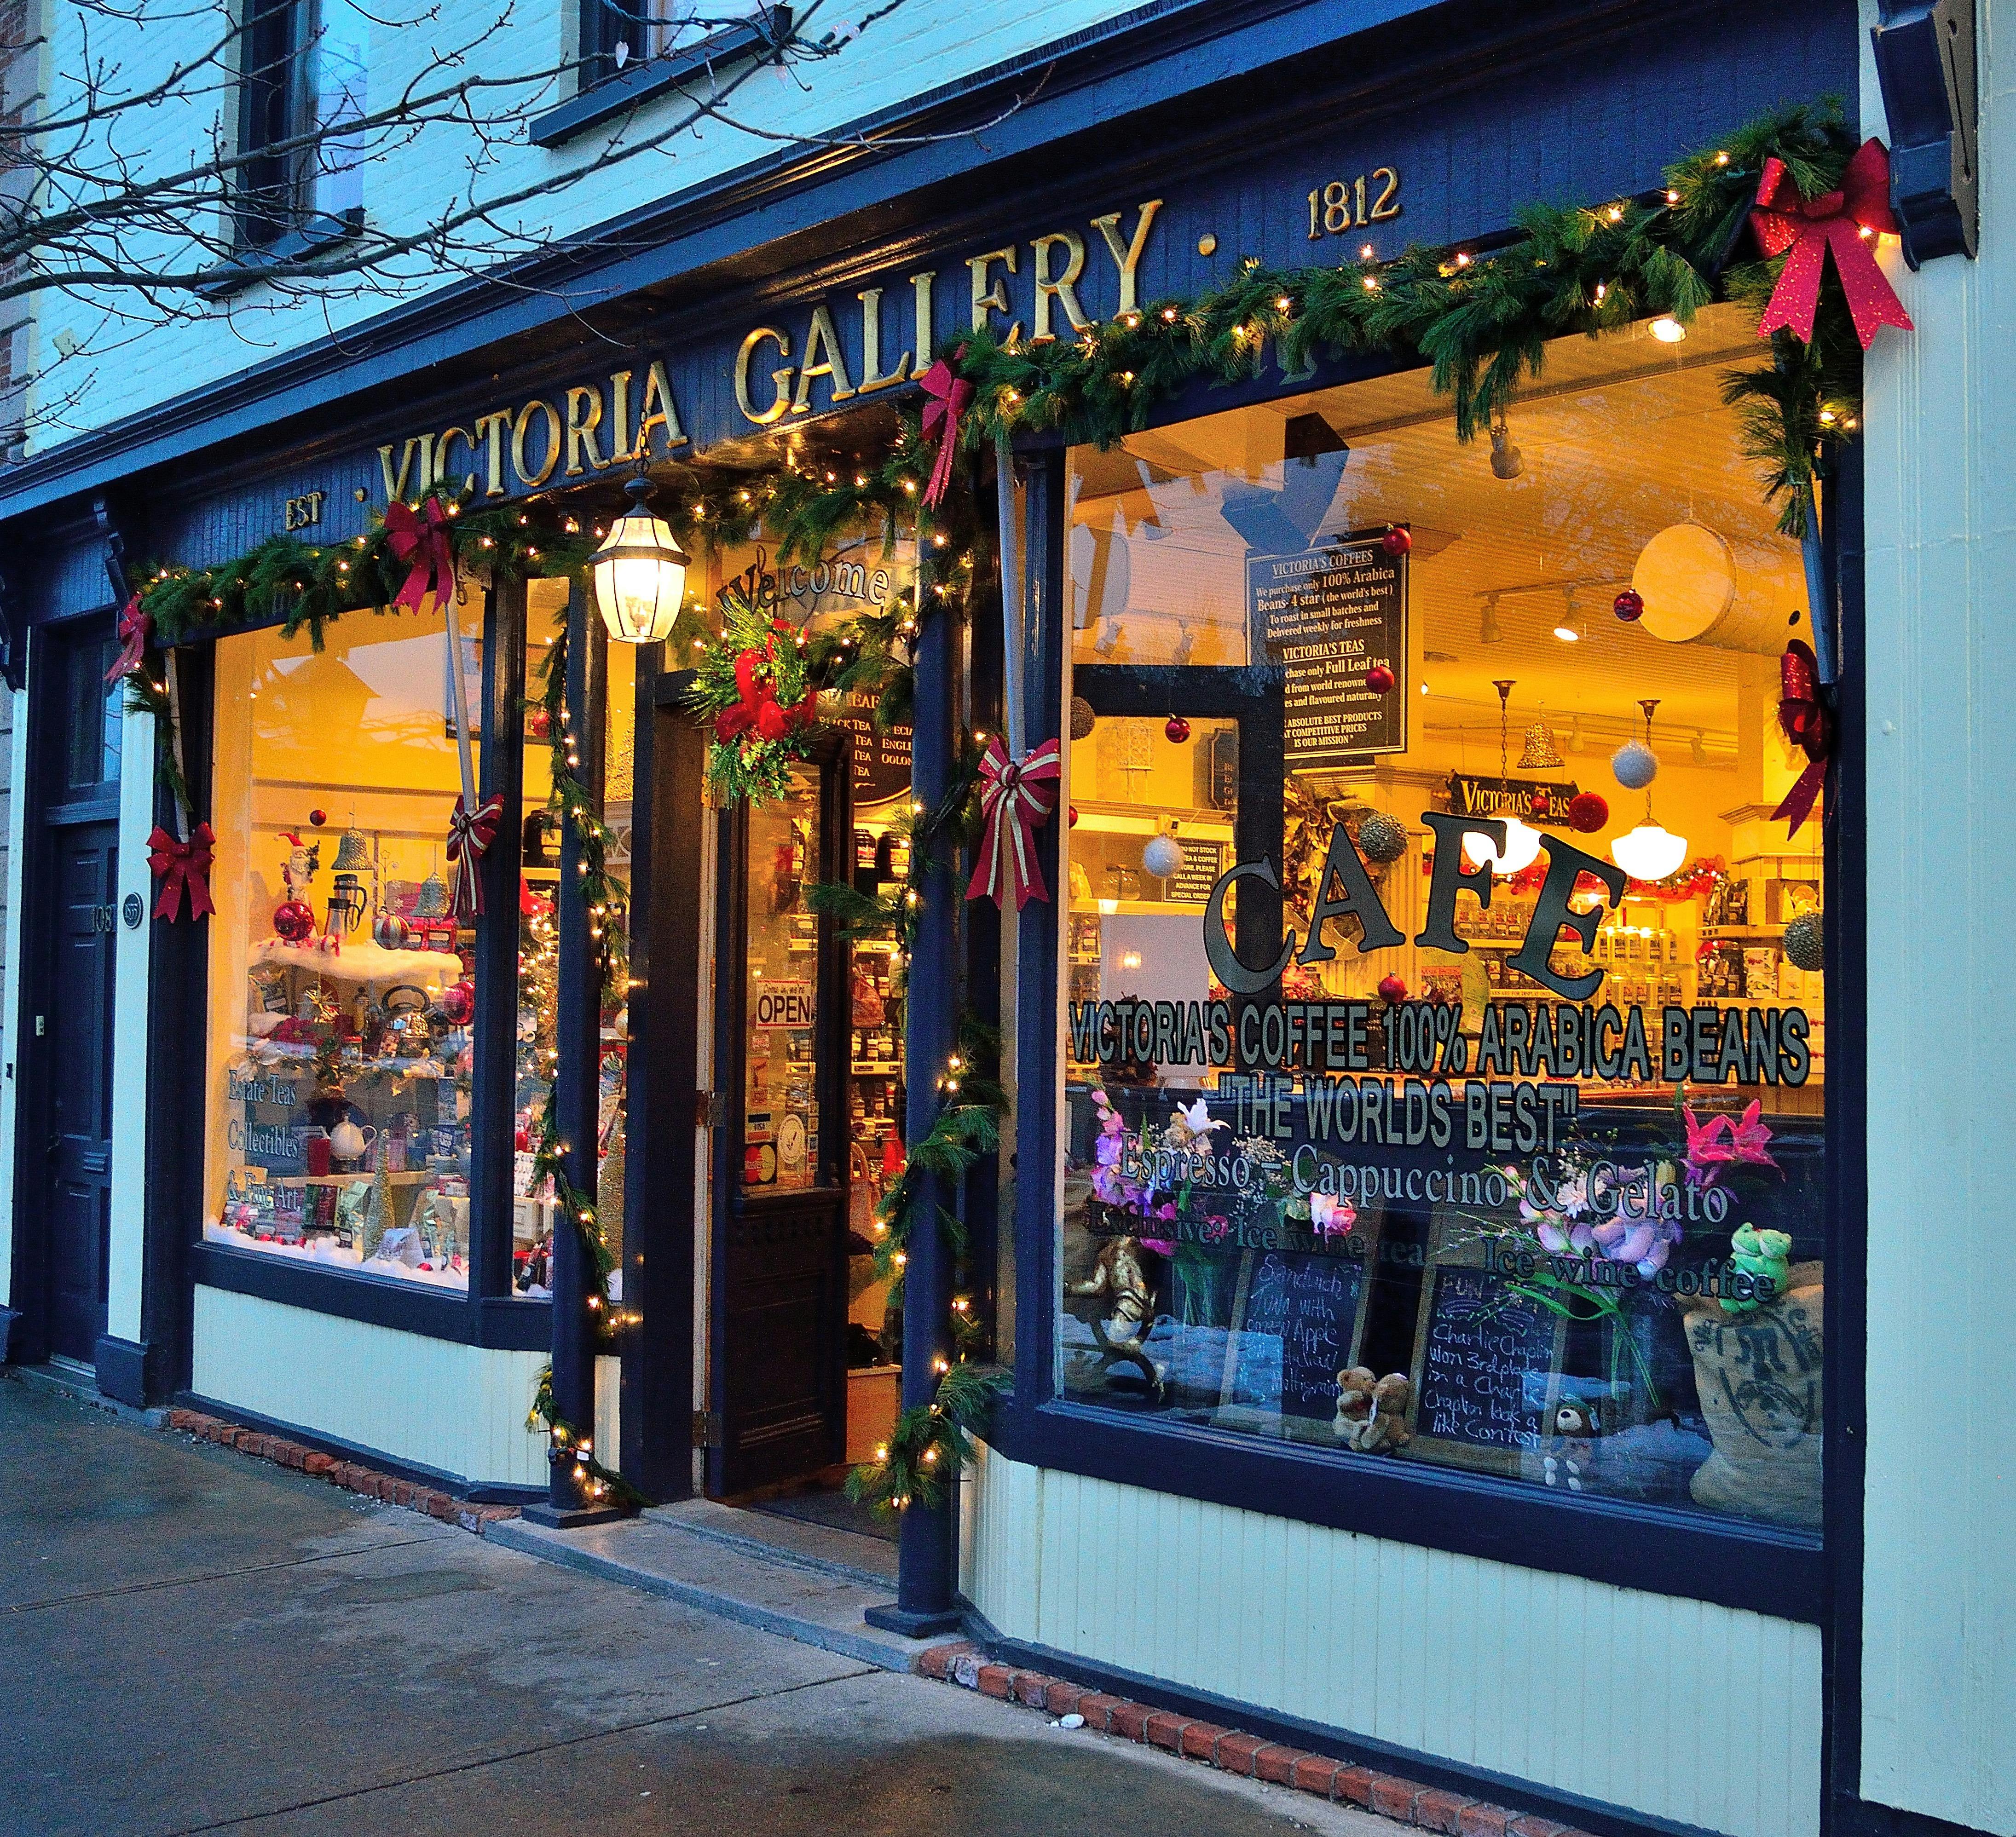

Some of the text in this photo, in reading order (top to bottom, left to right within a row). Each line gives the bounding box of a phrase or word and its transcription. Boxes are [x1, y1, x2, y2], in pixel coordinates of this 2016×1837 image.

[286, 491, 322, 530] EST
[376, 360, 688, 504] VICTORIA
[735, 198, 1164, 425] GALLERY
[1307, 167, 1401, 239] 1812
[1272, 549, 1373, 576] VICTORIA'S COFFEES
[716, 553, 889, 620] Welcome
[1256, 567, 1395, 598] We purchase only 100% Arabica
[1291, 593, 1298, 607] 4
[1300, 593, 1320, 605] star
[1341, 587, 1369, 601] world's
[1270, 601, 1379, 625] To roast in small batches and
[1267, 615, 1382, 639] Delivered weekly for freshness
[1282, 639, 1365, 661] VICTORIA'S TEAS
[1307, 665, 1324, 678] only
[1325, 659, 1345, 674] Full
[1347, 656, 1372, 672] Leaf
[1291, 683, 1310, 694] from
[1311, 680, 1333, 691] world
[1334, 679, 1366, 689] renowne
[1294, 696, 1308, 707] and
[1309, 692, 1345, 705] flavoured
[852, 719, 871, 731] TEA
[1287, 711, 1382, 728] ABSOLUTE BEST PRODUCTS
[1292, 725, 1340, 738] COMPETITIVE
[1340, 723, 1367, 733] PRICES
[855, 734, 872, 746] TEA
[1294, 738, 1301, 748] IS
[1302, 737, 1317, 747] OUR
[1461, 780, 1532, 815] VICTORIA'S
[1203, 811, 1628, 1002] CAFE
[758, 995, 810, 1023] OPEN
[1069, 1000, 1812, 1088] VICTORIA'S COFFEE 100% ARABICA BEANS
[228, 1070, 297, 1106] Estate Teas
[1303, 1075, 1453, 1149] WORLDS
[228, 1119, 298, 1158] Collectibles
[1120, 1130, 1251, 1191] Espresso
[1292, 1143, 1508, 1209] Cappuccino
[1525, 1156, 1569, 1213] &
[1586, 1158, 1730, 1224] Gelato
[1235, 1215, 1278, 1250] Ice
[1288, 1221, 1367, 1259] wine
[1481, 1236, 1776, 1304] Ice wine coffee
